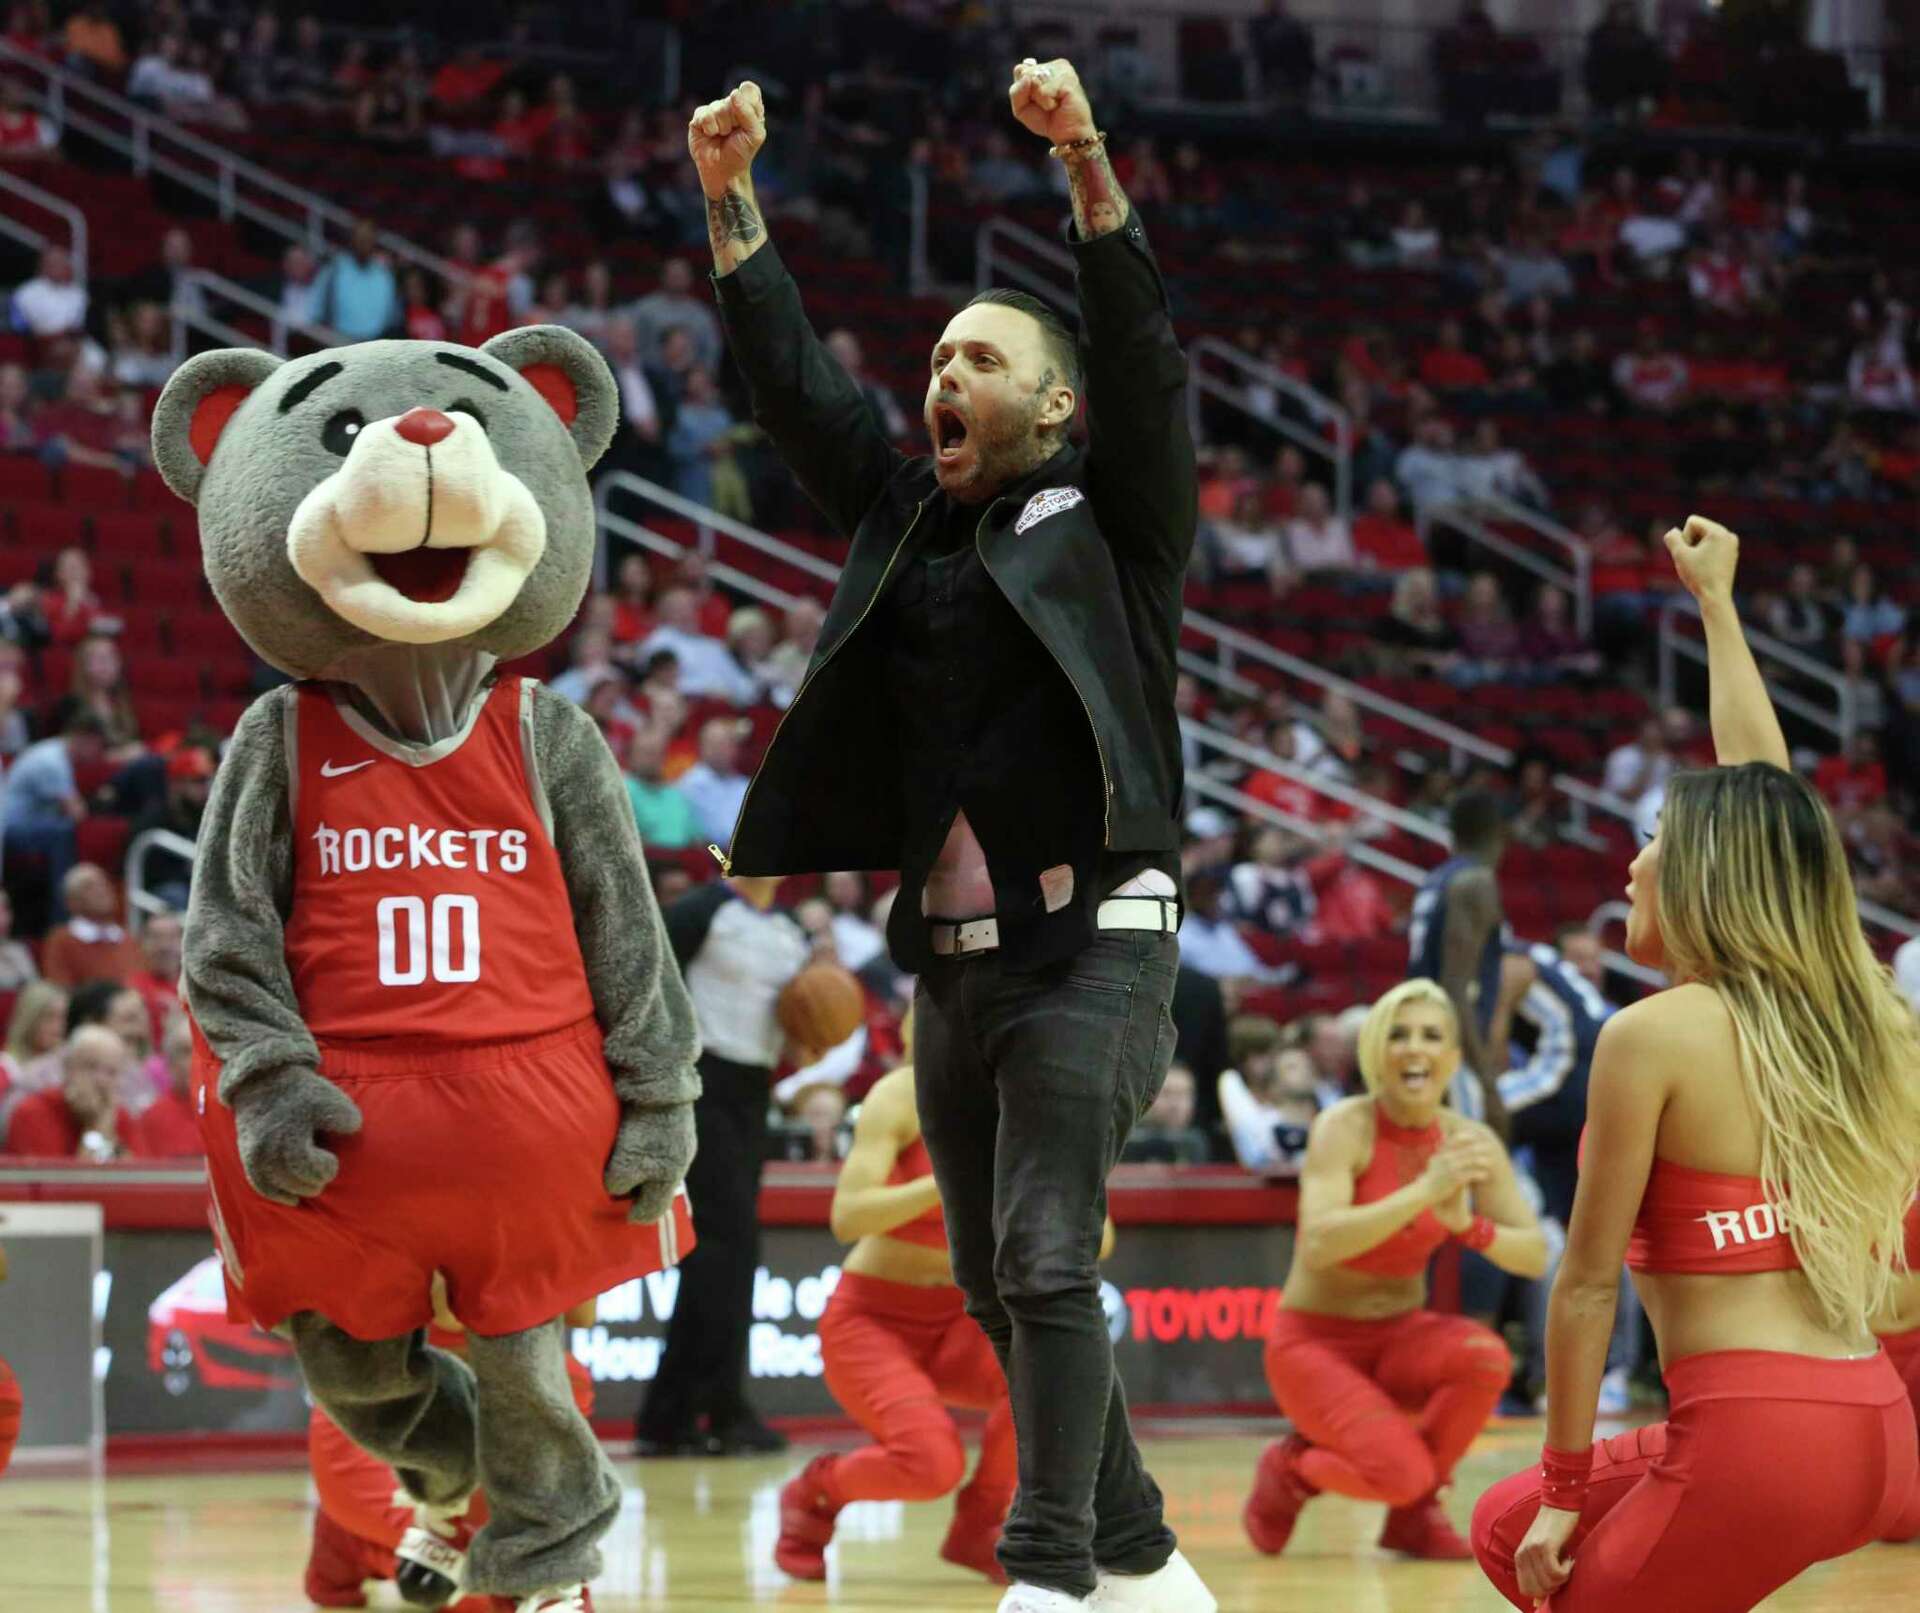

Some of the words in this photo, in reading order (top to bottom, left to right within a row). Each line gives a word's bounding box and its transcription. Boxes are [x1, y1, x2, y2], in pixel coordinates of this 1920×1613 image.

[1036, 489, 1081, 513] OCTOBER
[311, 822, 528, 876] ROCKETS
[377, 894, 480, 986] 00
